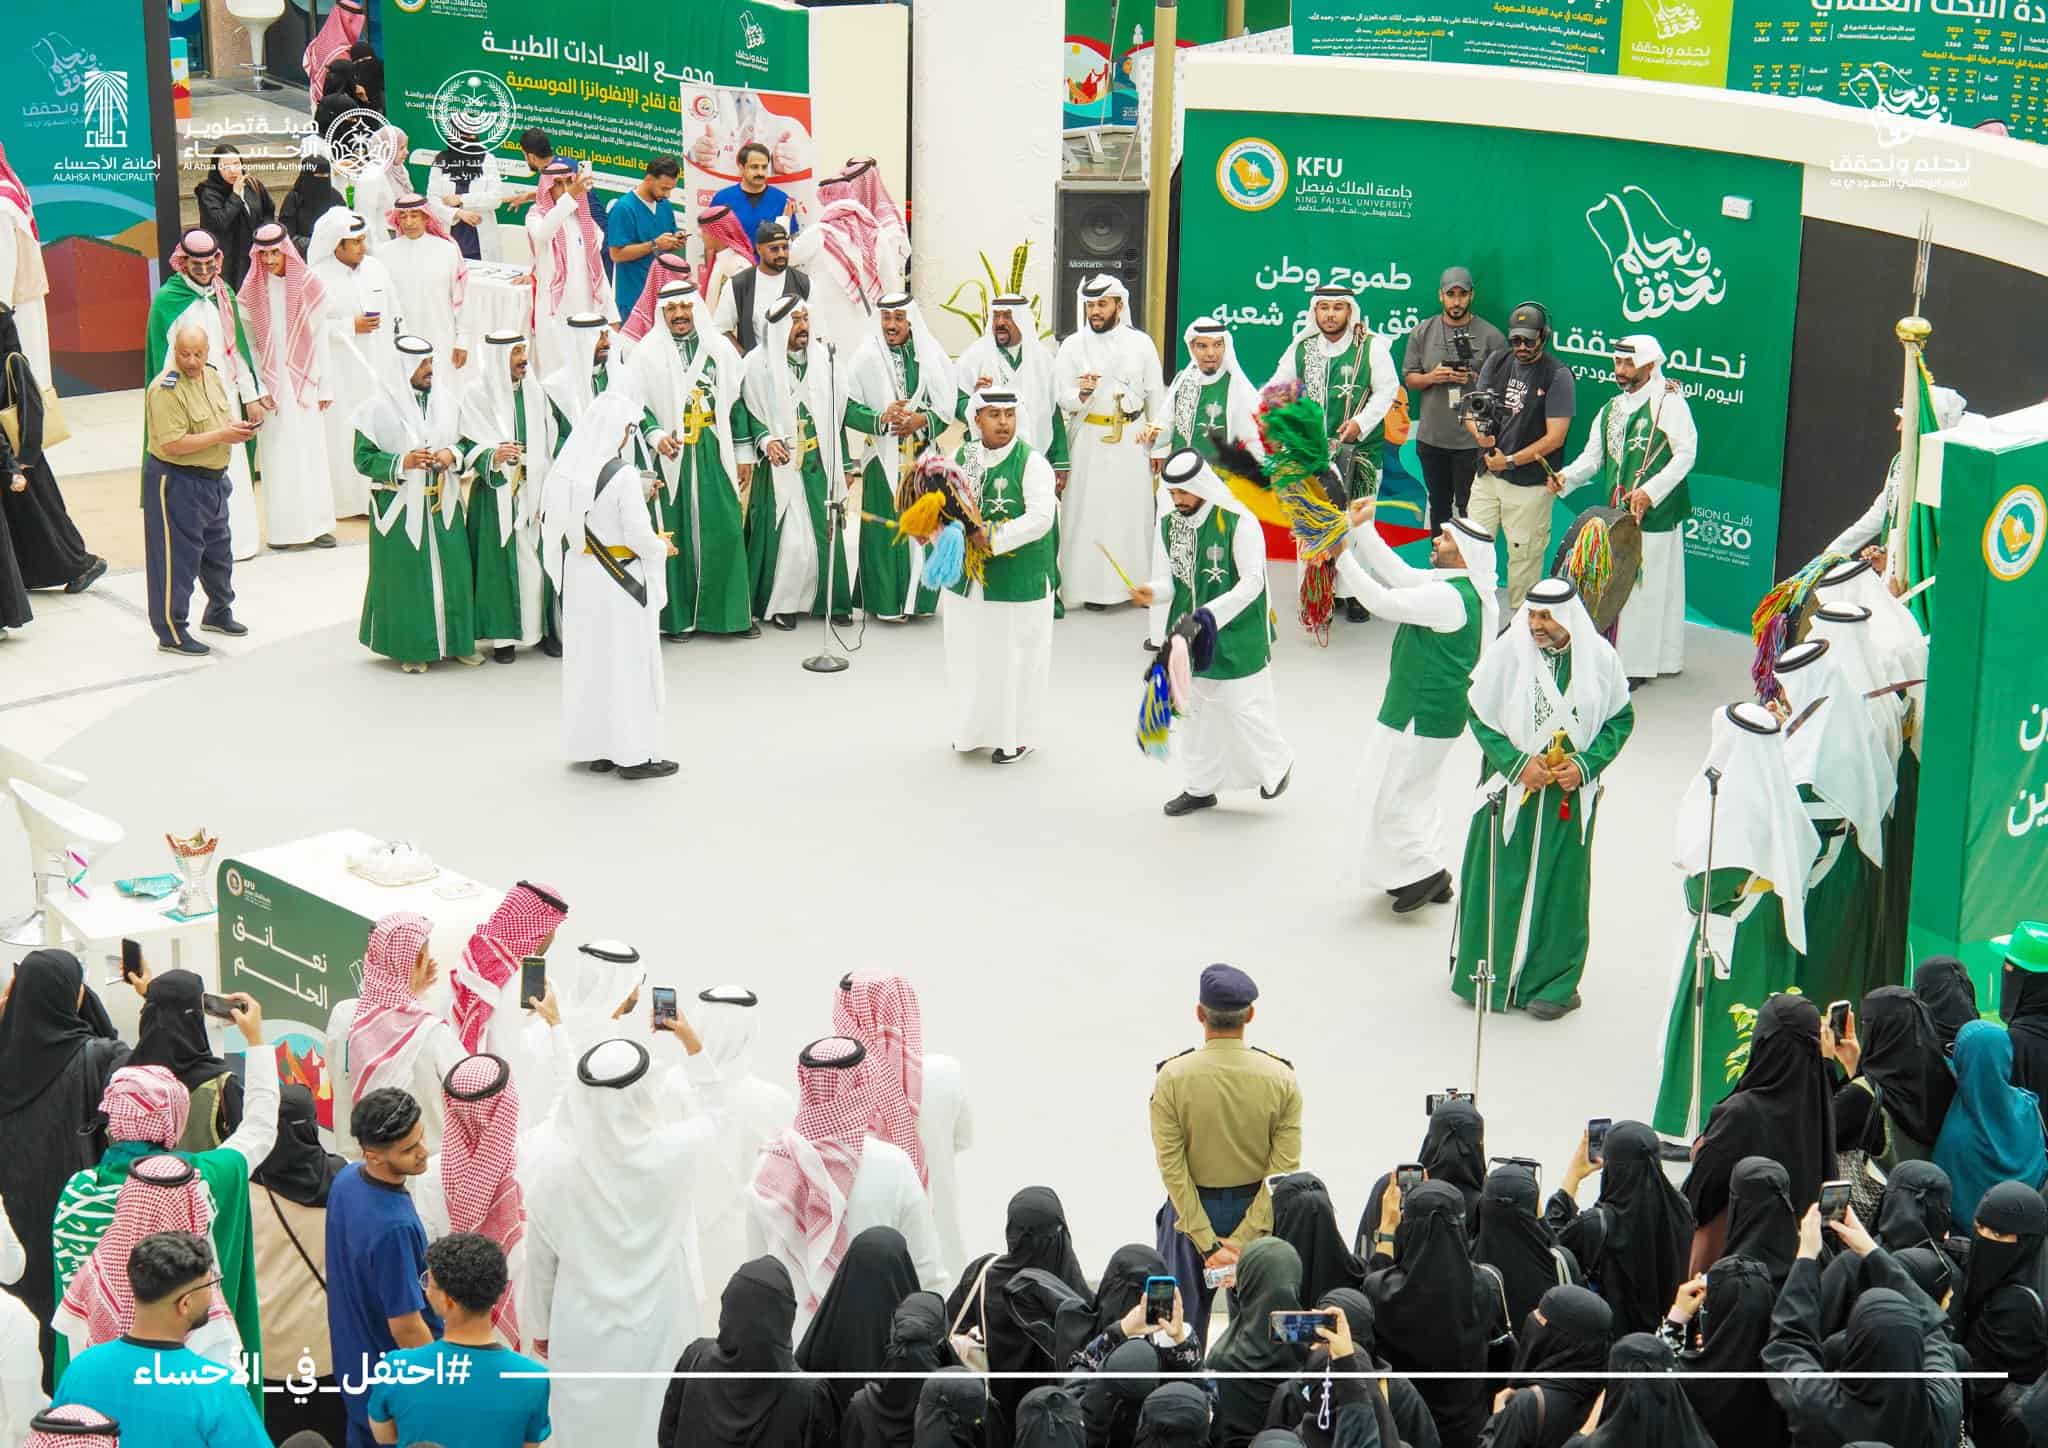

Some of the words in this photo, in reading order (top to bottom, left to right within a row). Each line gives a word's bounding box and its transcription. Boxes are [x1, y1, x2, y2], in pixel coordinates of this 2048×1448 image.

[481, 30, 559, 61] الطبية
[563, 40, 649, 76] العيادات
[506, 71, 577, 96] الموسمية
[640, 93, 667, 113] لقاح
[1295, 156, 1343, 178] KFU
[1295, 178, 1334, 195] فيصل
[1336, 178, 1374, 198] الملك
[1375, 184, 1413, 200] جامعة
[1295, 195, 1318, 205] KING
[1321, 197, 1353, 207] FAISAL
[1356, 199, 1414, 210] UNIVERSITY
[1256, 256, 1321, 292] وطن
[1330, 262, 1412, 294] طموح
[1211, 300, 1284, 331] شعبه
[1666, 347, 1747, 380] نحلم
[1704, 388, 1744, 405] اليوم
[1685, 518, 1752, 550] 2030
[232, 914, 328, 973] نعانق
[234, 956, 328, 1010] الحلم
